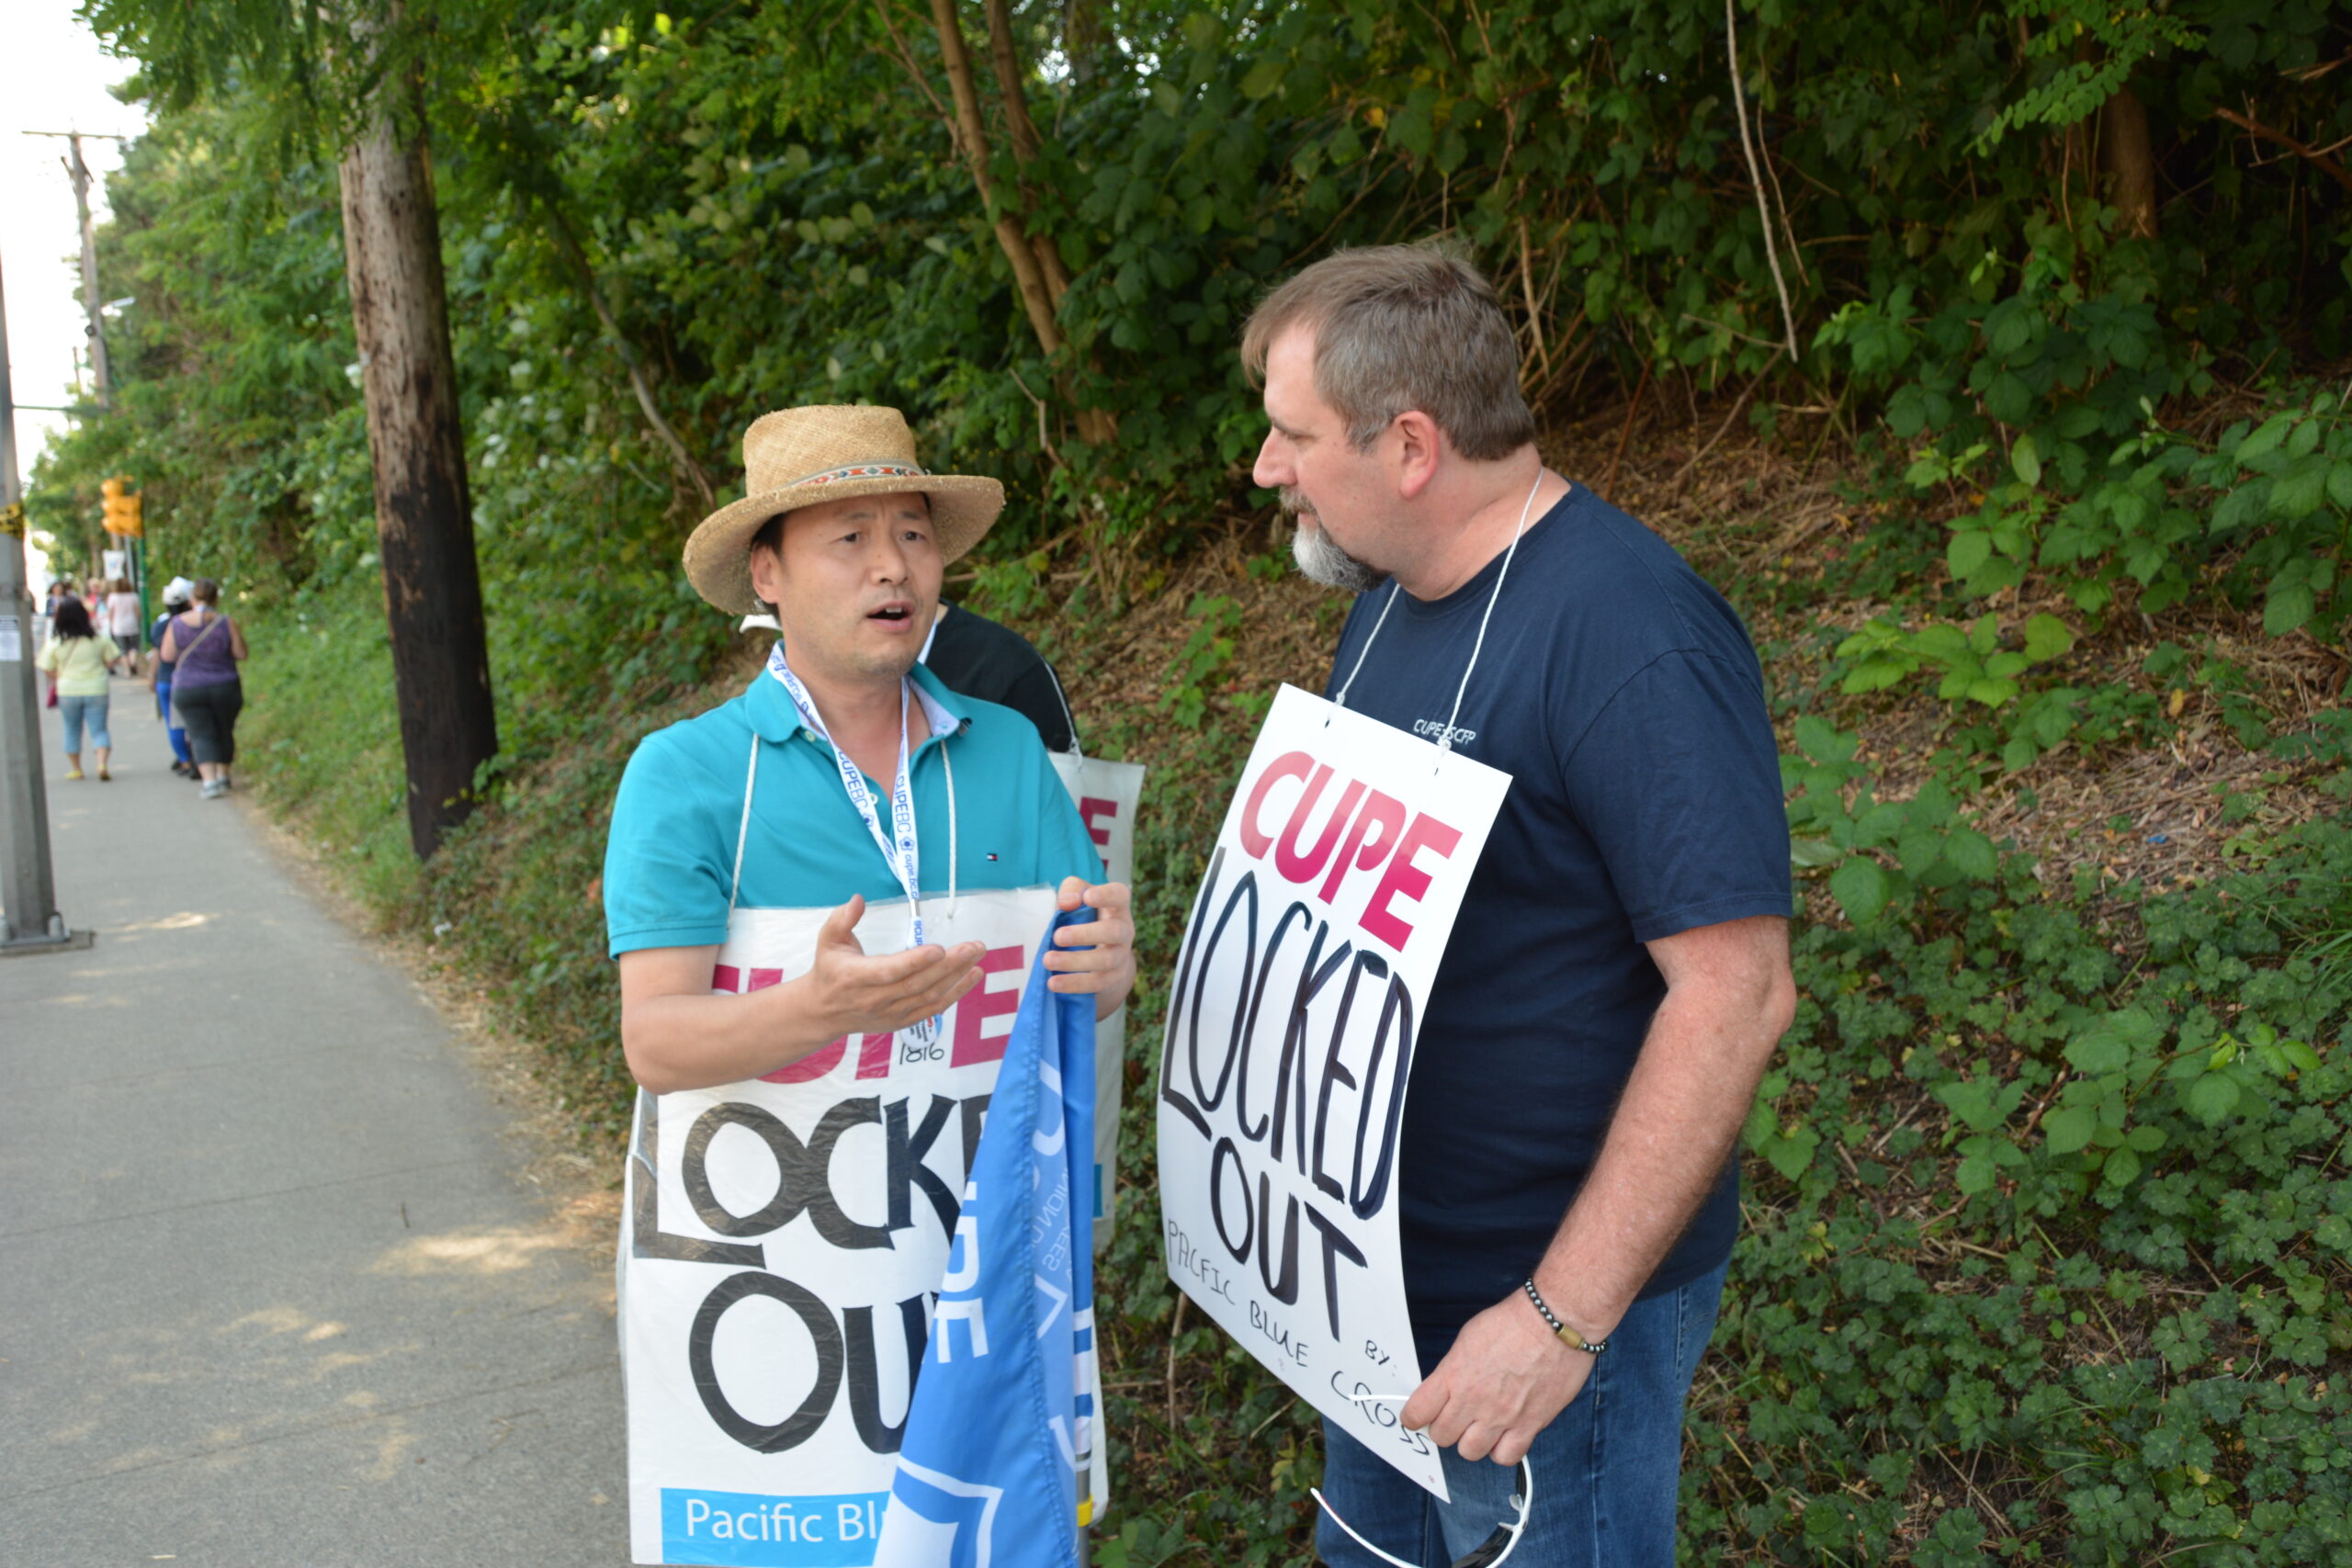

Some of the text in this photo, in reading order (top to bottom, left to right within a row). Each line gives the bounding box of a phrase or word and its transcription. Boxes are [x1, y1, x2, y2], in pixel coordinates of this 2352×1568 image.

[1239, 750, 1464, 953] CUPE
[1160, 845, 1414, 1220] LOCKED
[631, 1091, 993, 1269] LOCK
[1211, 1136, 1368, 1343] OUT
[689, 1270, 939, 1455] OU
[1168, 1218, 1236, 1306] PACFIC
[1250, 1300, 1309, 1368] BLUE
[686, 1498, 887, 1543] Pacific Bl
